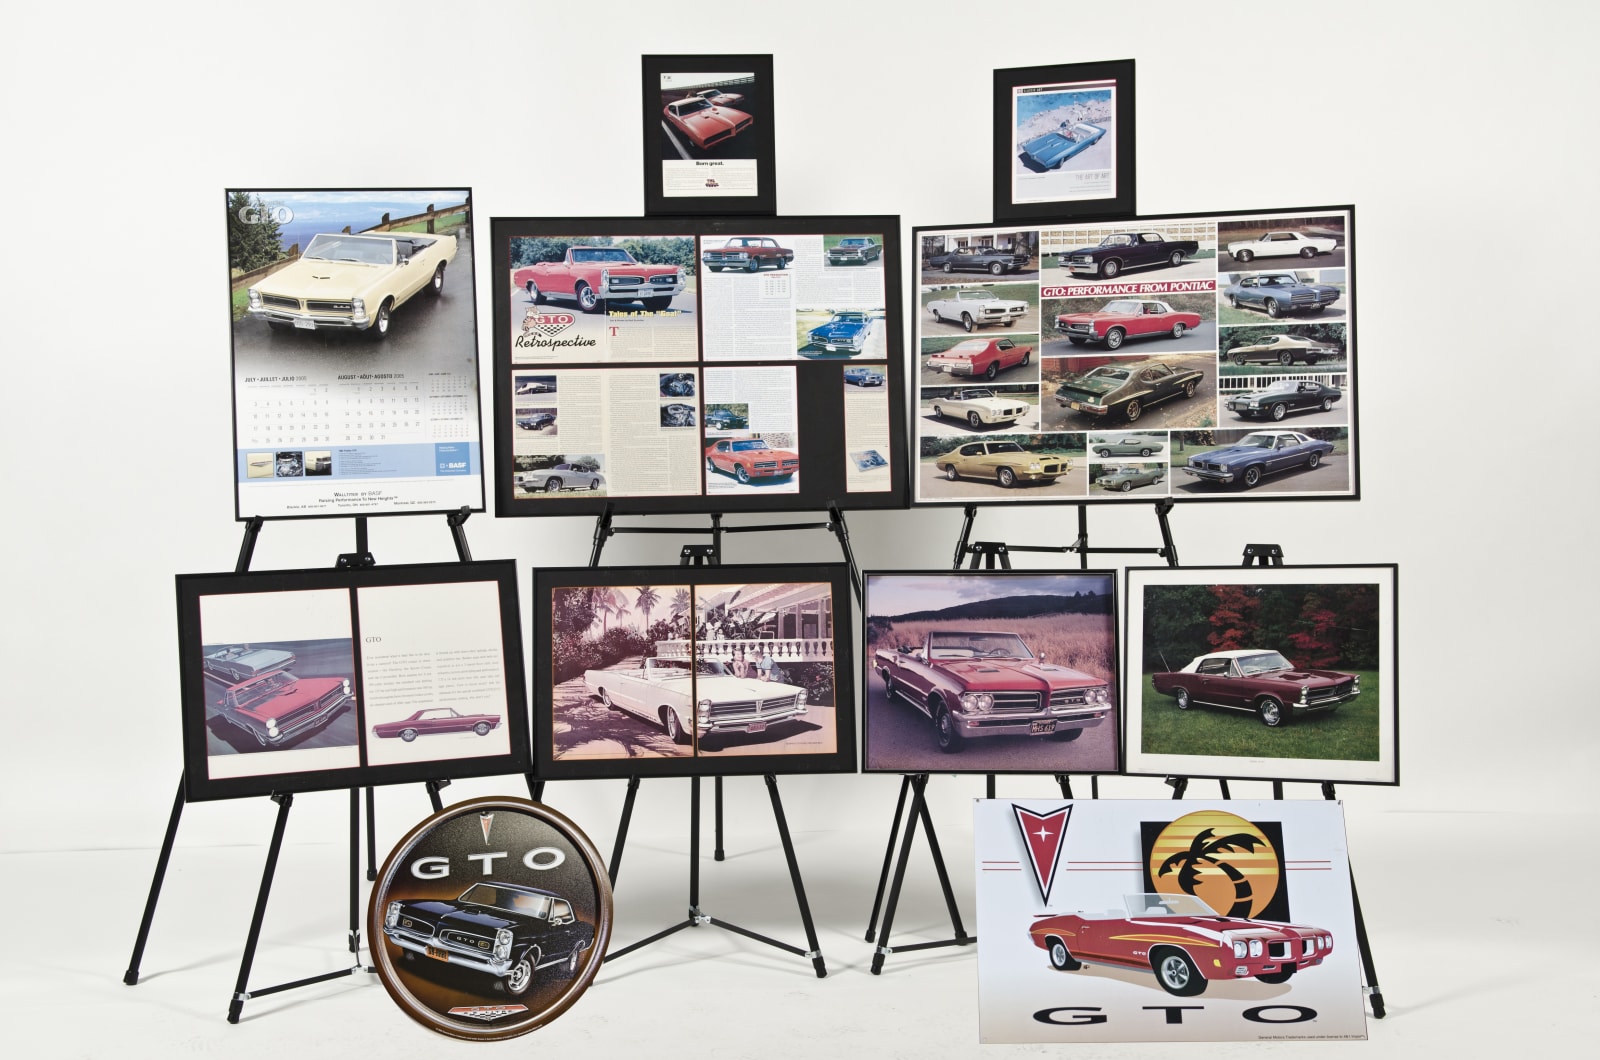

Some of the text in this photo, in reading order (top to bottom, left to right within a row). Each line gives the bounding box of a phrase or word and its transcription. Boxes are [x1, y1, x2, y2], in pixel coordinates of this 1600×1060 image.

[238, 205, 294, 225] GTO
[1043, 280, 1214, 297] GTO: PERFORMANCE FROM PONTIAC
[535, 315, 568, 324] GTO
[514, 334, 597, 352] Retrospective
[410, 846, 566, 880] GTO
[456, 936, 476, 944] GTO
[1032, 1005, 1318, 1026] GTO
